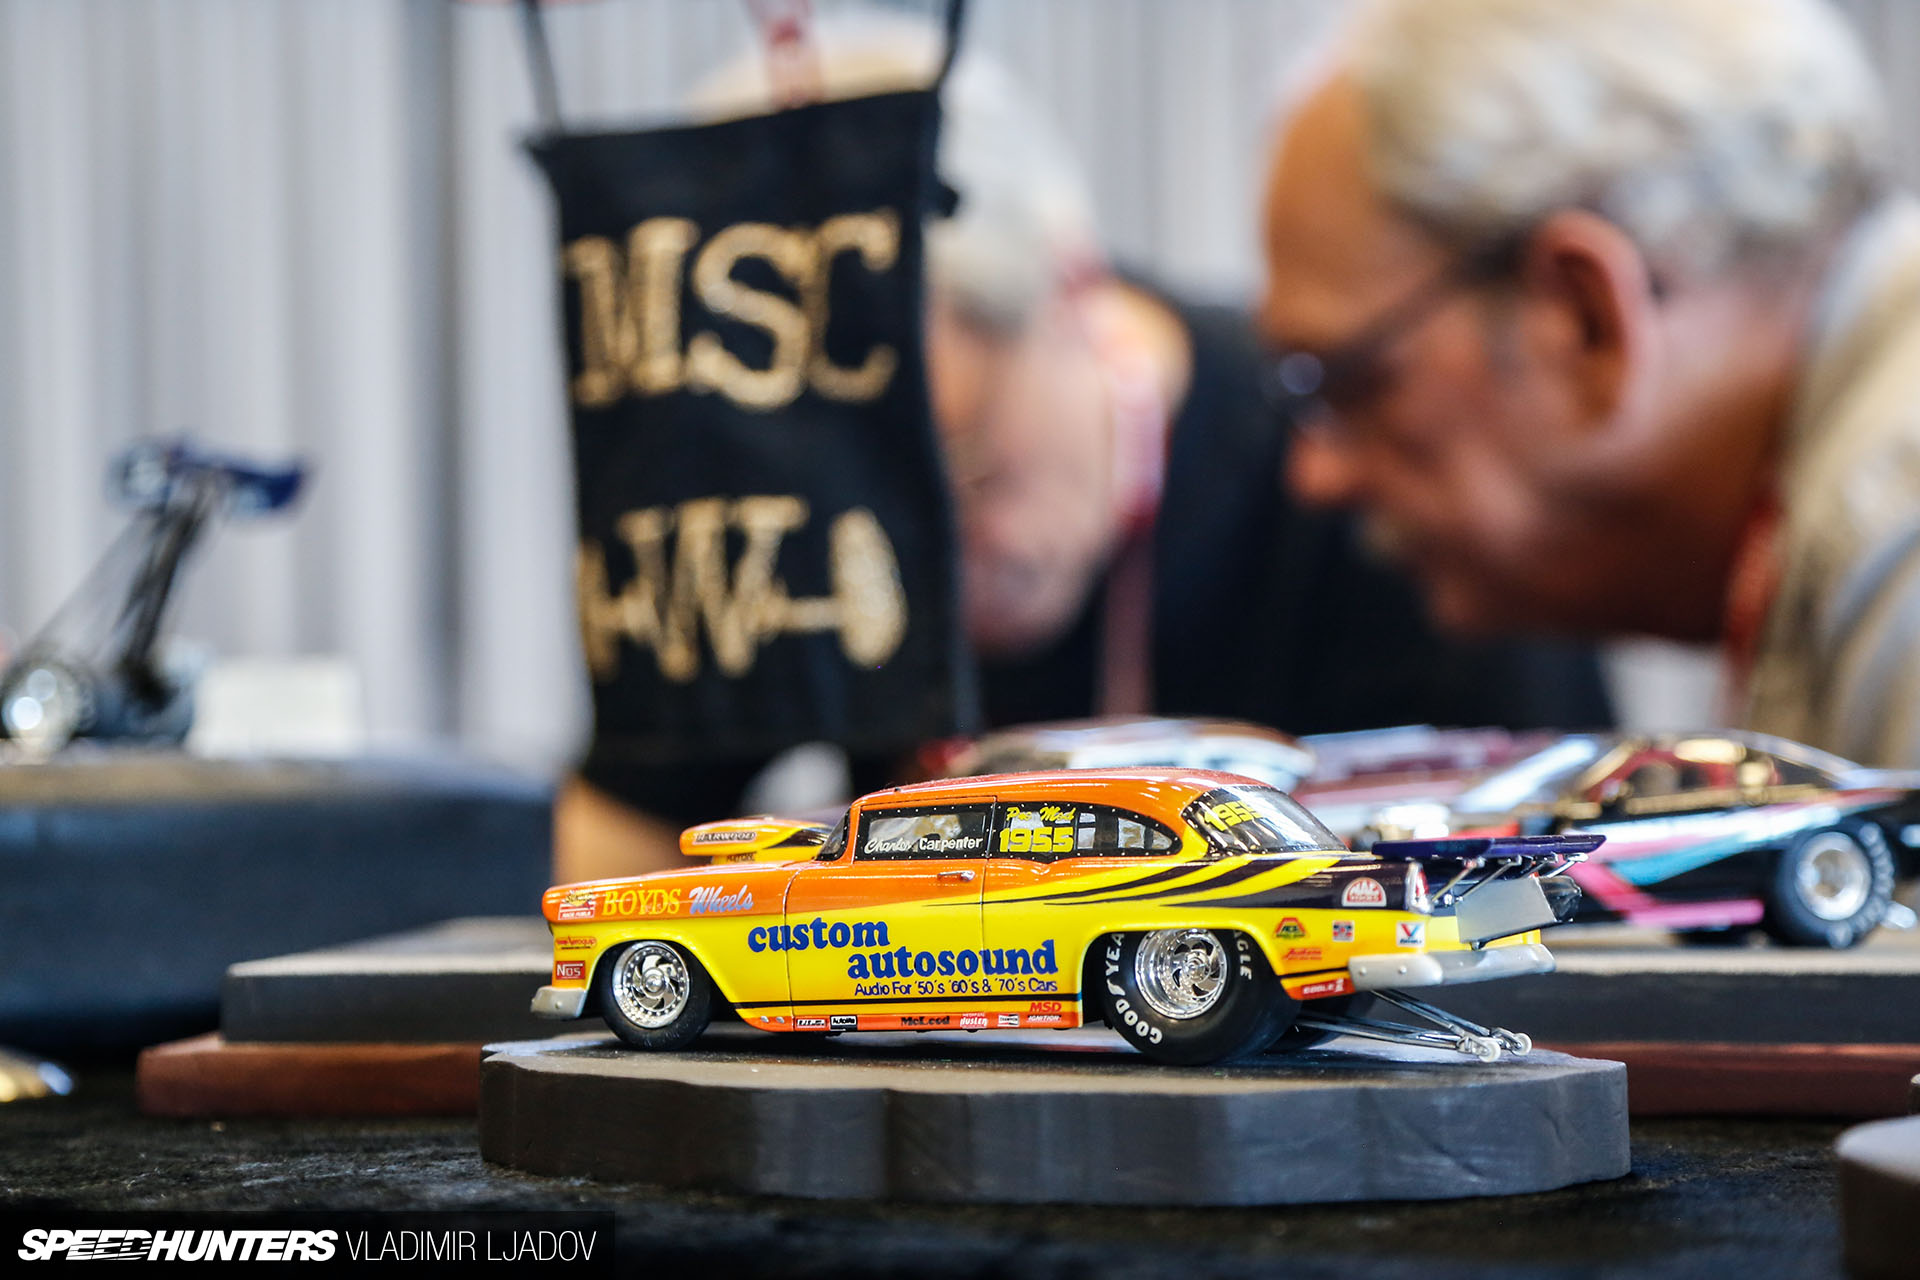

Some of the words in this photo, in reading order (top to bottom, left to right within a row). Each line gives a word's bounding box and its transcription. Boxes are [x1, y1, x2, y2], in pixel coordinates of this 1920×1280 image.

[563, 209, 900, 407] MSC
[1040, 806, 1076, 822] Mod
[919, 836, 983, 851] Carpenter
[1000, 827, 1074, 853] 1955
[602, 888, 681, 916] BOYDS
[689, 884, 754, 914] Wheels
[748, 917, 890, 952] custom
[848, 939, 1058, 979] autosound
[557, 963, 583, 977] NOS
[854, 982, 890, 996] Audio
[892, 981, 912, 995] For
[982, 979, 992, 993] &
[1028, 977, 1058, 991] Cars
[1030, 1002, 1062, 1012] MSD
[901, 1016, 950, 1026] McLeod
